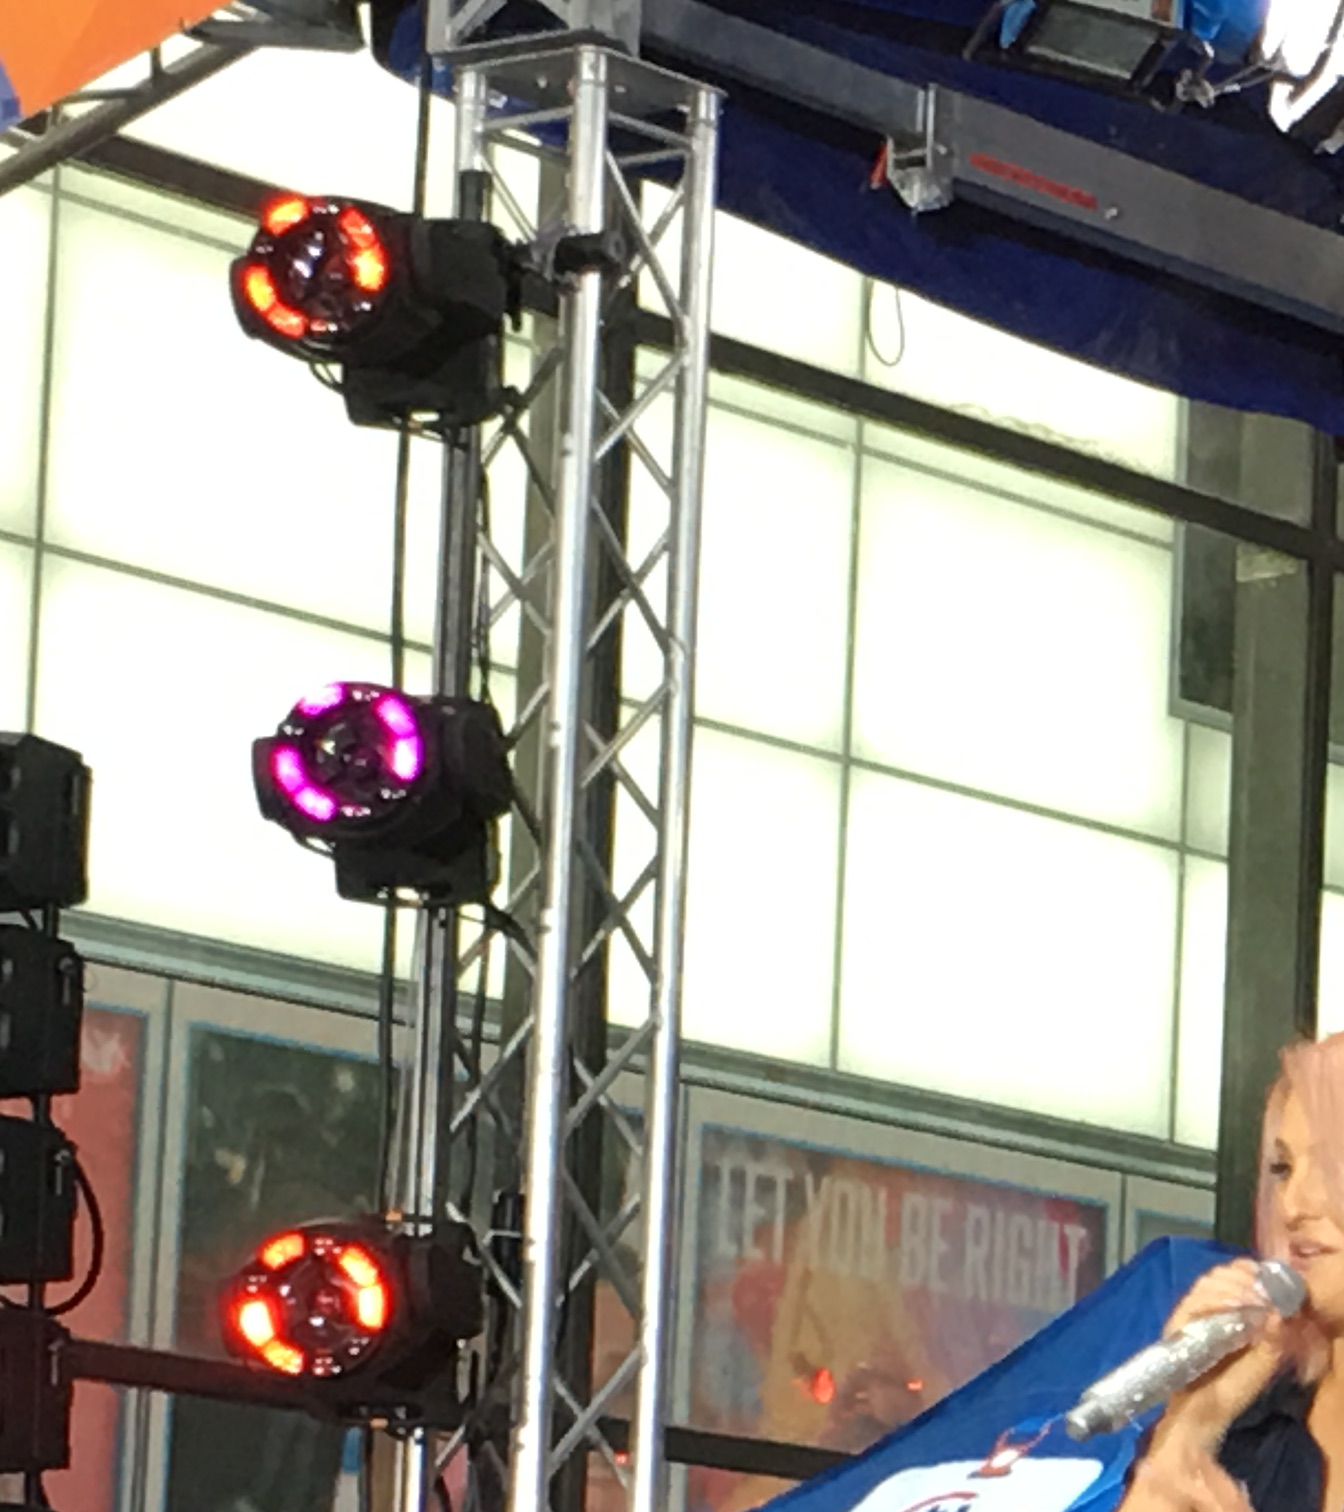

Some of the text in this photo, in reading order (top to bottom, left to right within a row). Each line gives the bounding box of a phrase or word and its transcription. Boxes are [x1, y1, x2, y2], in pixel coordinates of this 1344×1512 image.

[718, 1157, 794, 1265] LET
[900, 1191, 955, 1294] BE
[964, 1203, 1087, 1307] RIGHT
